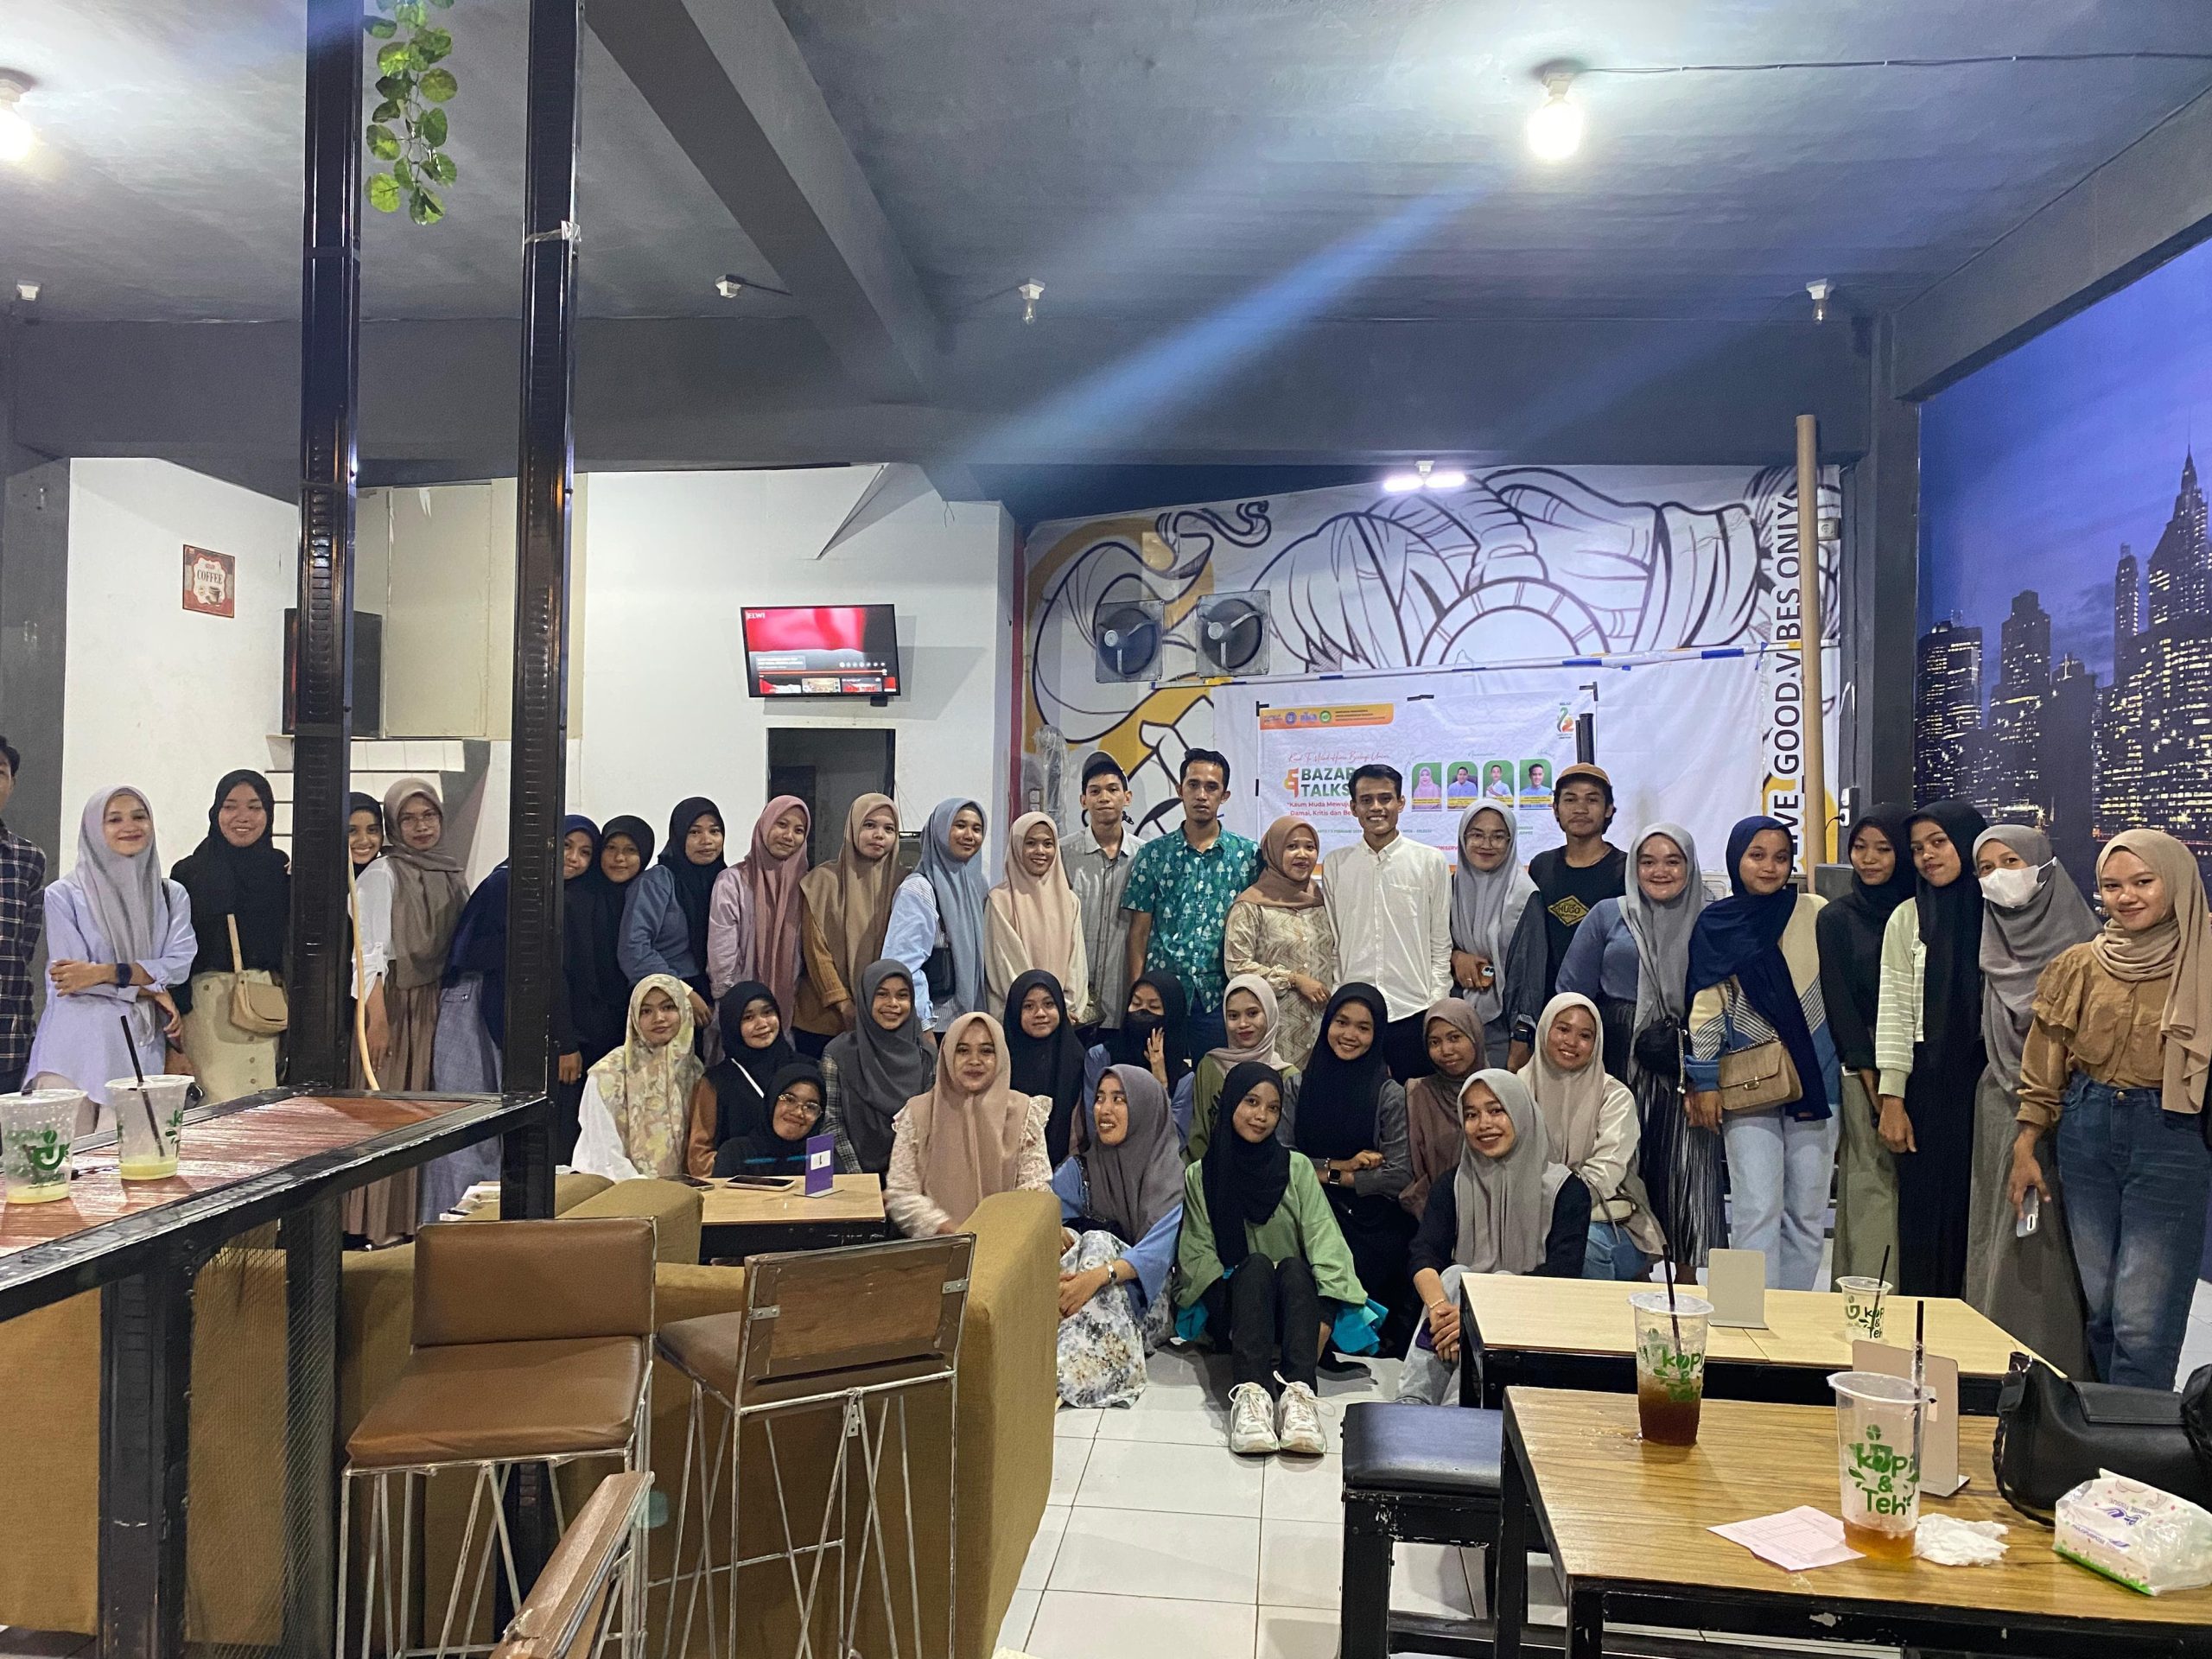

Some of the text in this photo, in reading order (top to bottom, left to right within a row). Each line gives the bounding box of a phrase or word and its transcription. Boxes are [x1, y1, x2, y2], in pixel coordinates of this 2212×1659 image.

[197, 569, 223, 585] COFFEE
[1301, 766, 1355, 781] BAZAR
[1300, 783, 1351, 797] TALKS
[1558, 904, 1581, 914] HUGO
[1877, 1474, 1894, 1493] &
[1861, 1486, 1906, 1516] Teh
